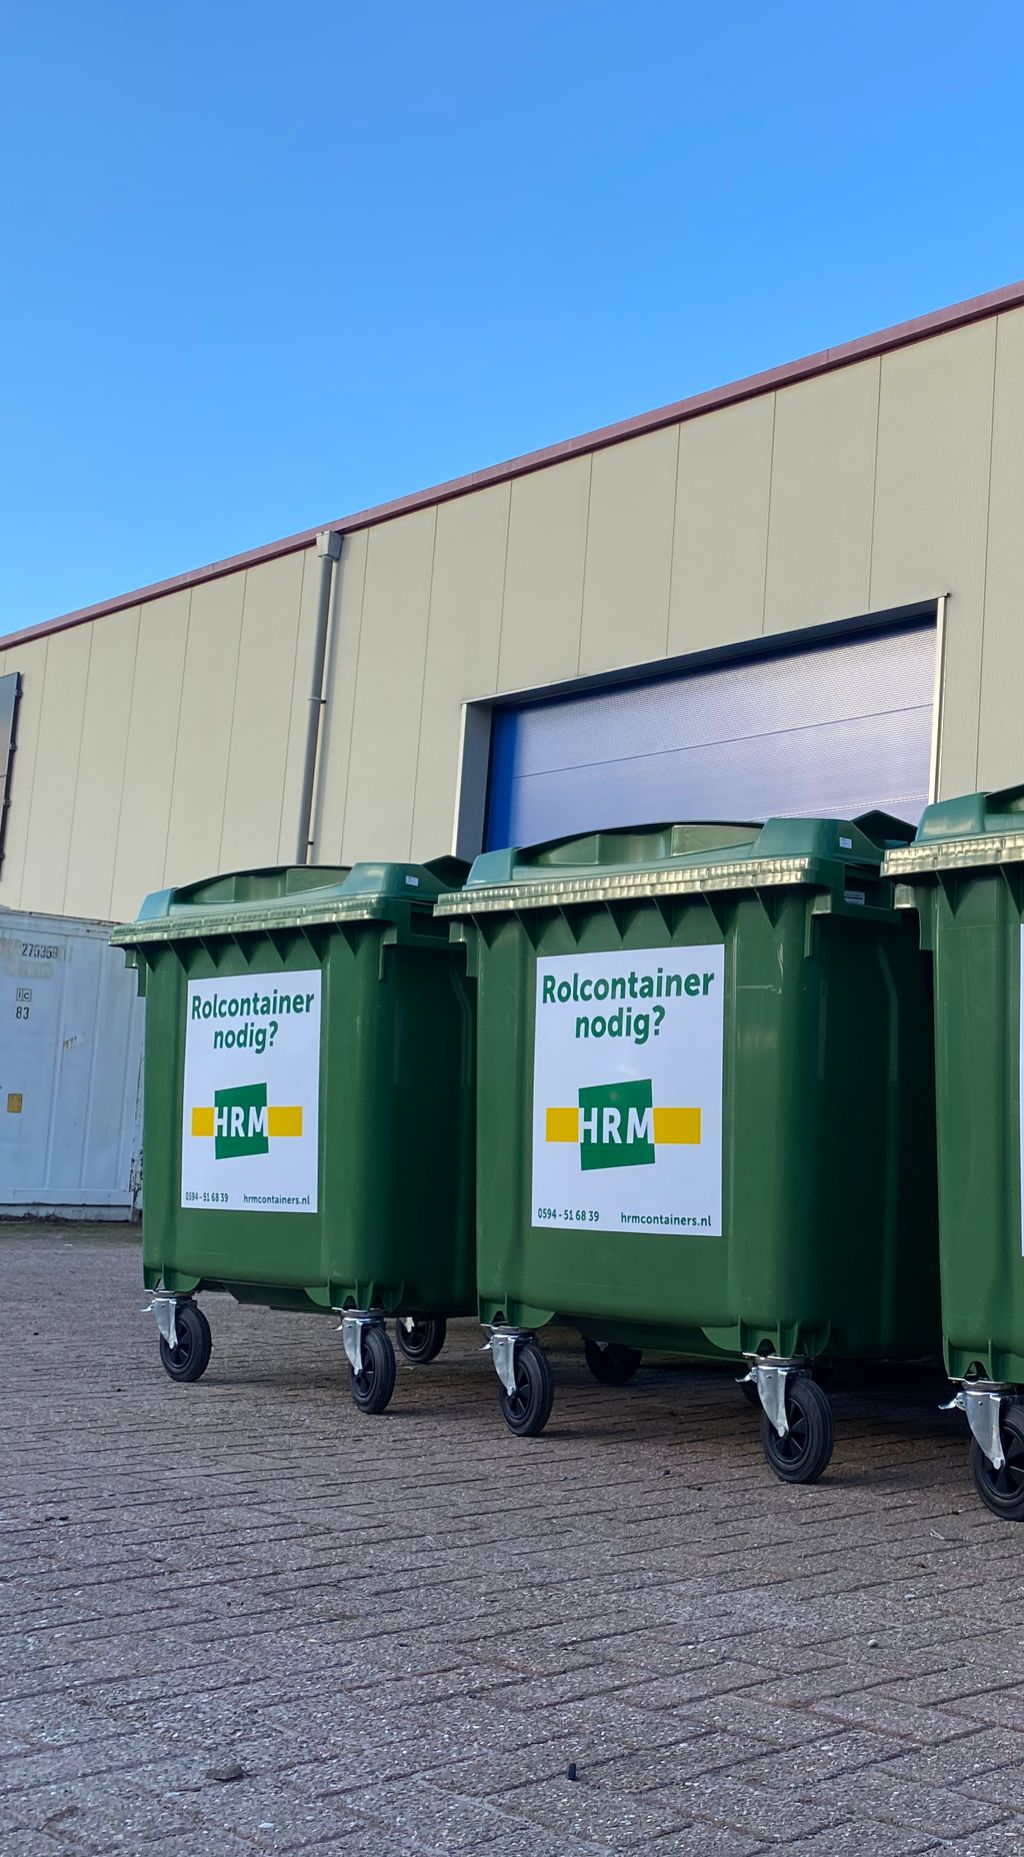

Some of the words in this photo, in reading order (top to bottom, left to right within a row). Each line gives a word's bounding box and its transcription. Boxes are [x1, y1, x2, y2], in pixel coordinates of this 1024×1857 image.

[542, 967, 715, 1004] Rolcontainer
[16, 1006, 30, 1020] 83
[191, 989, 315, 1020] Rolcontainer
[213, 1020, 279, 1054] nodig?
[575, 1005, 666, 1045] nodig?
[214, 1106, 269, 1137] HRM
[579, 1107, 655, 1144] HRM
[203, 1192, 211, 1202] 51
[211, 1192, 220, 1202] 68
[220, 1193, 229, 1203] 39
[243, 1193, 310, 1205] hrmcontainers.nl
[537, 1207, 557, 1220] 0594
[563, 1209, 574, 1221] 51
[575, 1210, 586, 1221] 68
[588, 1210, 600, 1222] 39
[620, 1212, 712, 1227] hrmcontainers.nl
